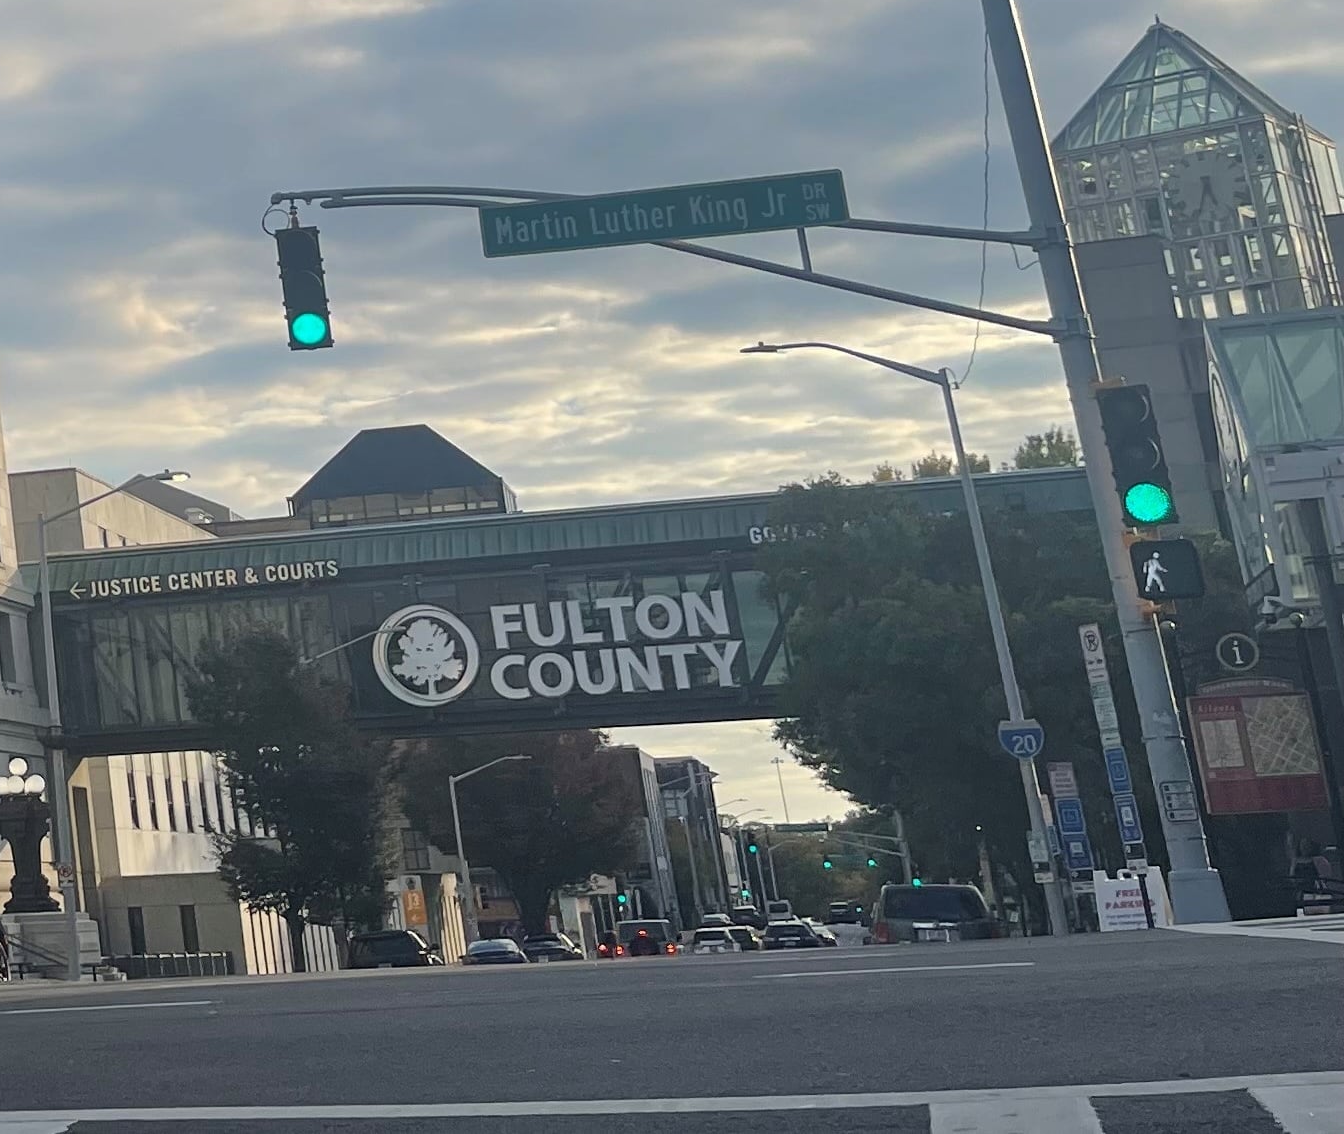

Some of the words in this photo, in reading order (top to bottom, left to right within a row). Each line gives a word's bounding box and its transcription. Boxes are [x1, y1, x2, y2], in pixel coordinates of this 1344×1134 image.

[495, 212, 578, 245] Martin
[589, 203, 676, 235] Luther
[688, 194, 747, 229] King
[762, 191, 788, 218] Jr
[802, 182, 826, 200] DR
[806, 203, 830, 222] SW
[90, 575, 162, 598] JUSTICE
[168, 568, 238, 591] CENTER
[245, 567, 259, 584] &
[265, 560, 339, 582] COURTS
[490, 589, 731, 650] FULTON
[490, 640, 744, 700] COUNTY
[1012, 734, 1037, 754] 20
